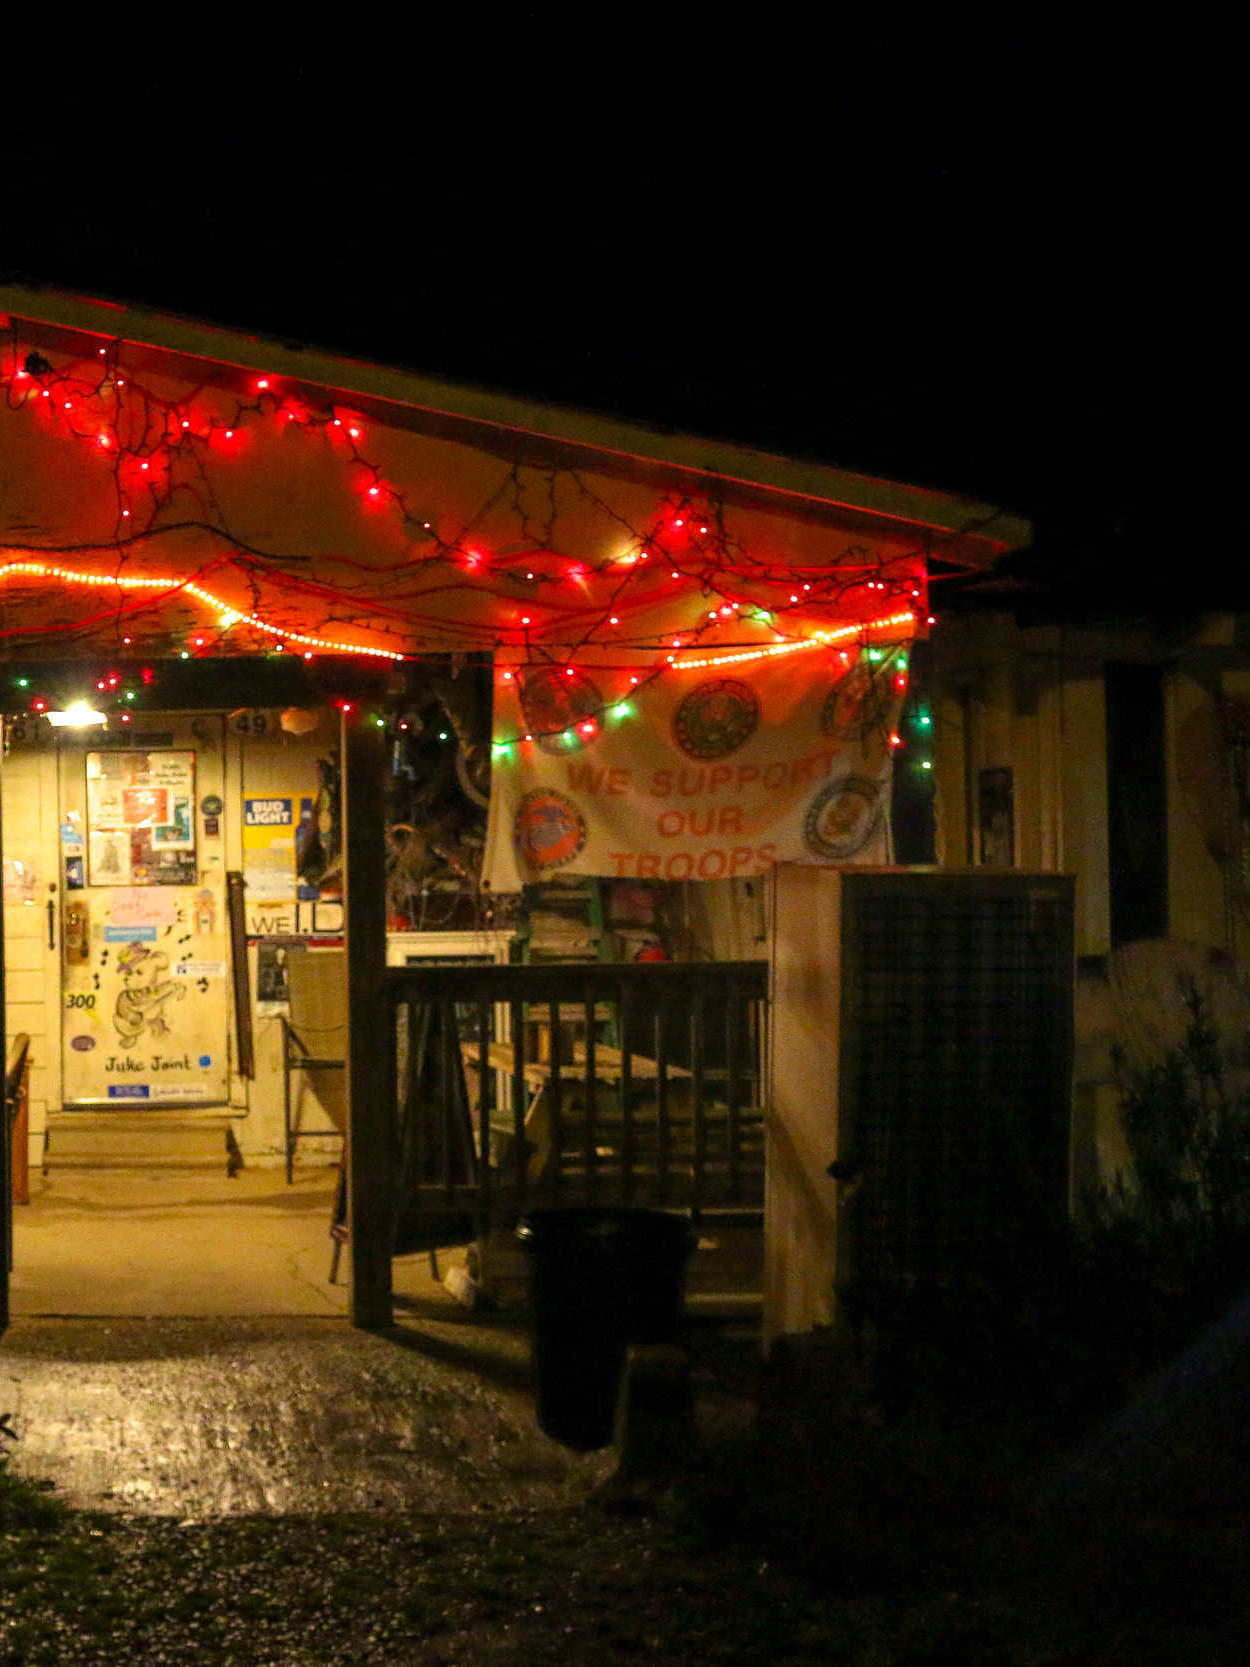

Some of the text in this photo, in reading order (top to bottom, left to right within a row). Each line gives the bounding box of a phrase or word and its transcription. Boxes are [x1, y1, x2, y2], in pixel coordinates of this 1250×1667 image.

[236, 715, 267, 733] 49
[567, 745, 842, 797] WE SUPPORT
[251, 800, 285, 812] BUD
[246, 811, 291, 825] LIGHT
[656, 806, 743, 839] OUR
[608, 843, 777, 881] TROOPS
[252, 916, 290, 934] WE
[66, 995, 95, 1009] 300
[105, 1054, 191, 1072] Juke Joint
